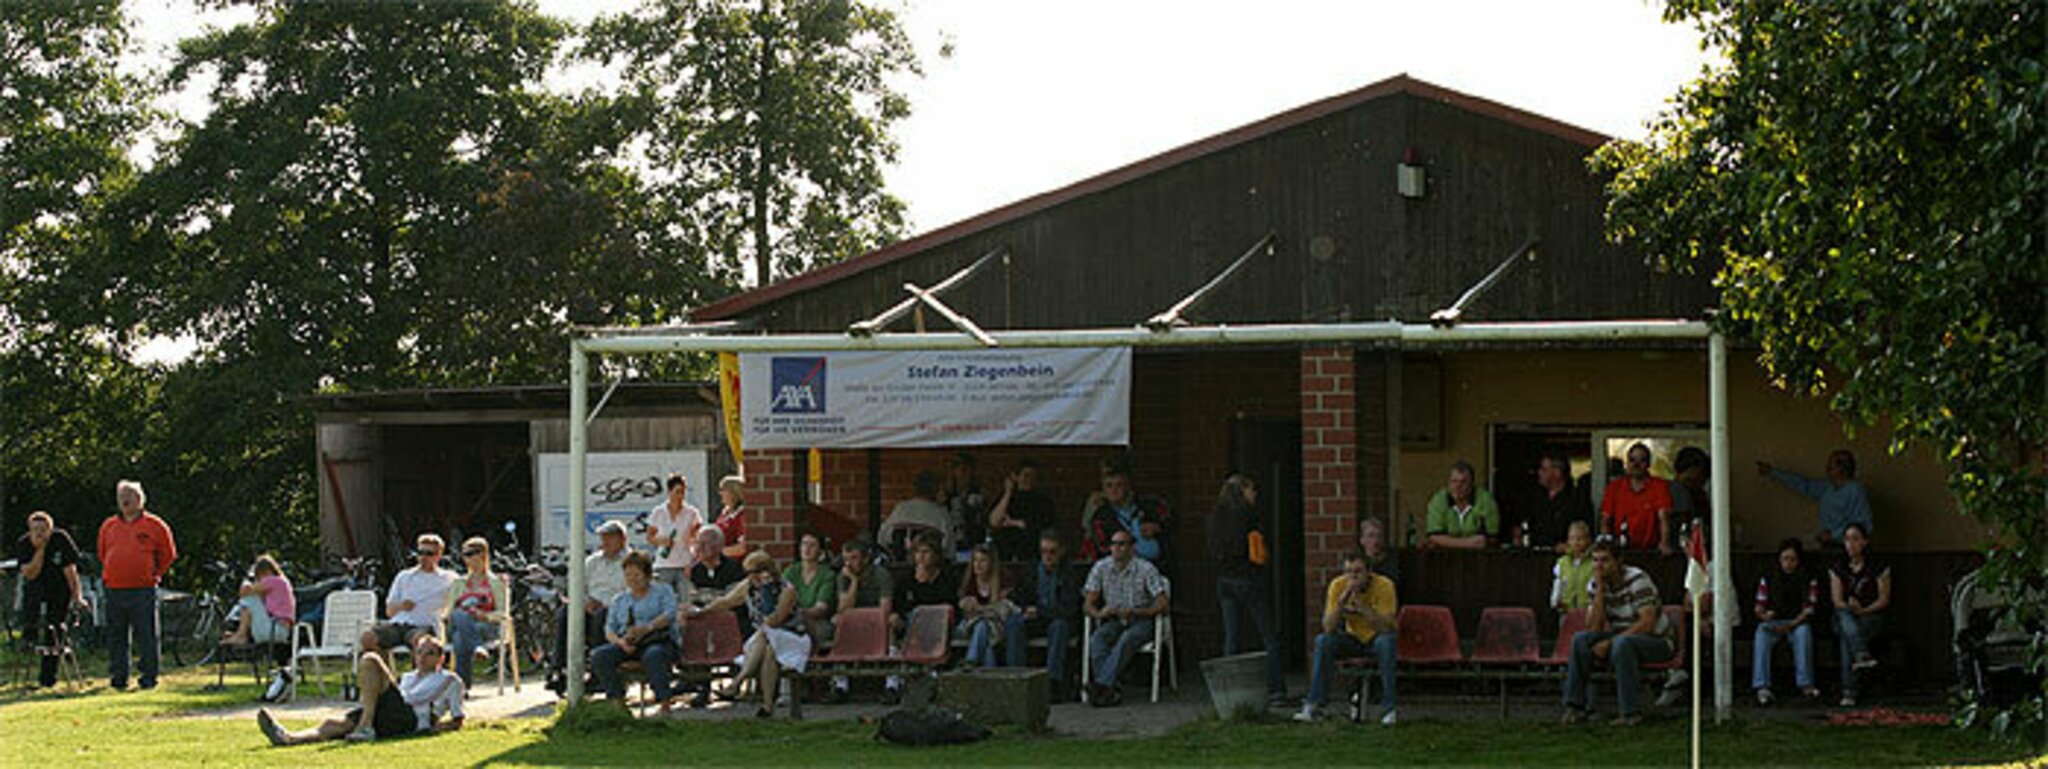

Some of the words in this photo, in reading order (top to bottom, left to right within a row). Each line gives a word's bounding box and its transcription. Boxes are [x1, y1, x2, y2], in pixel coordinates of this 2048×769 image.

[907, 365, 959, 379] Stefan
[964, 363, 1055, 381] Ziegenbein
[771, 384, 816, 409] AXA
